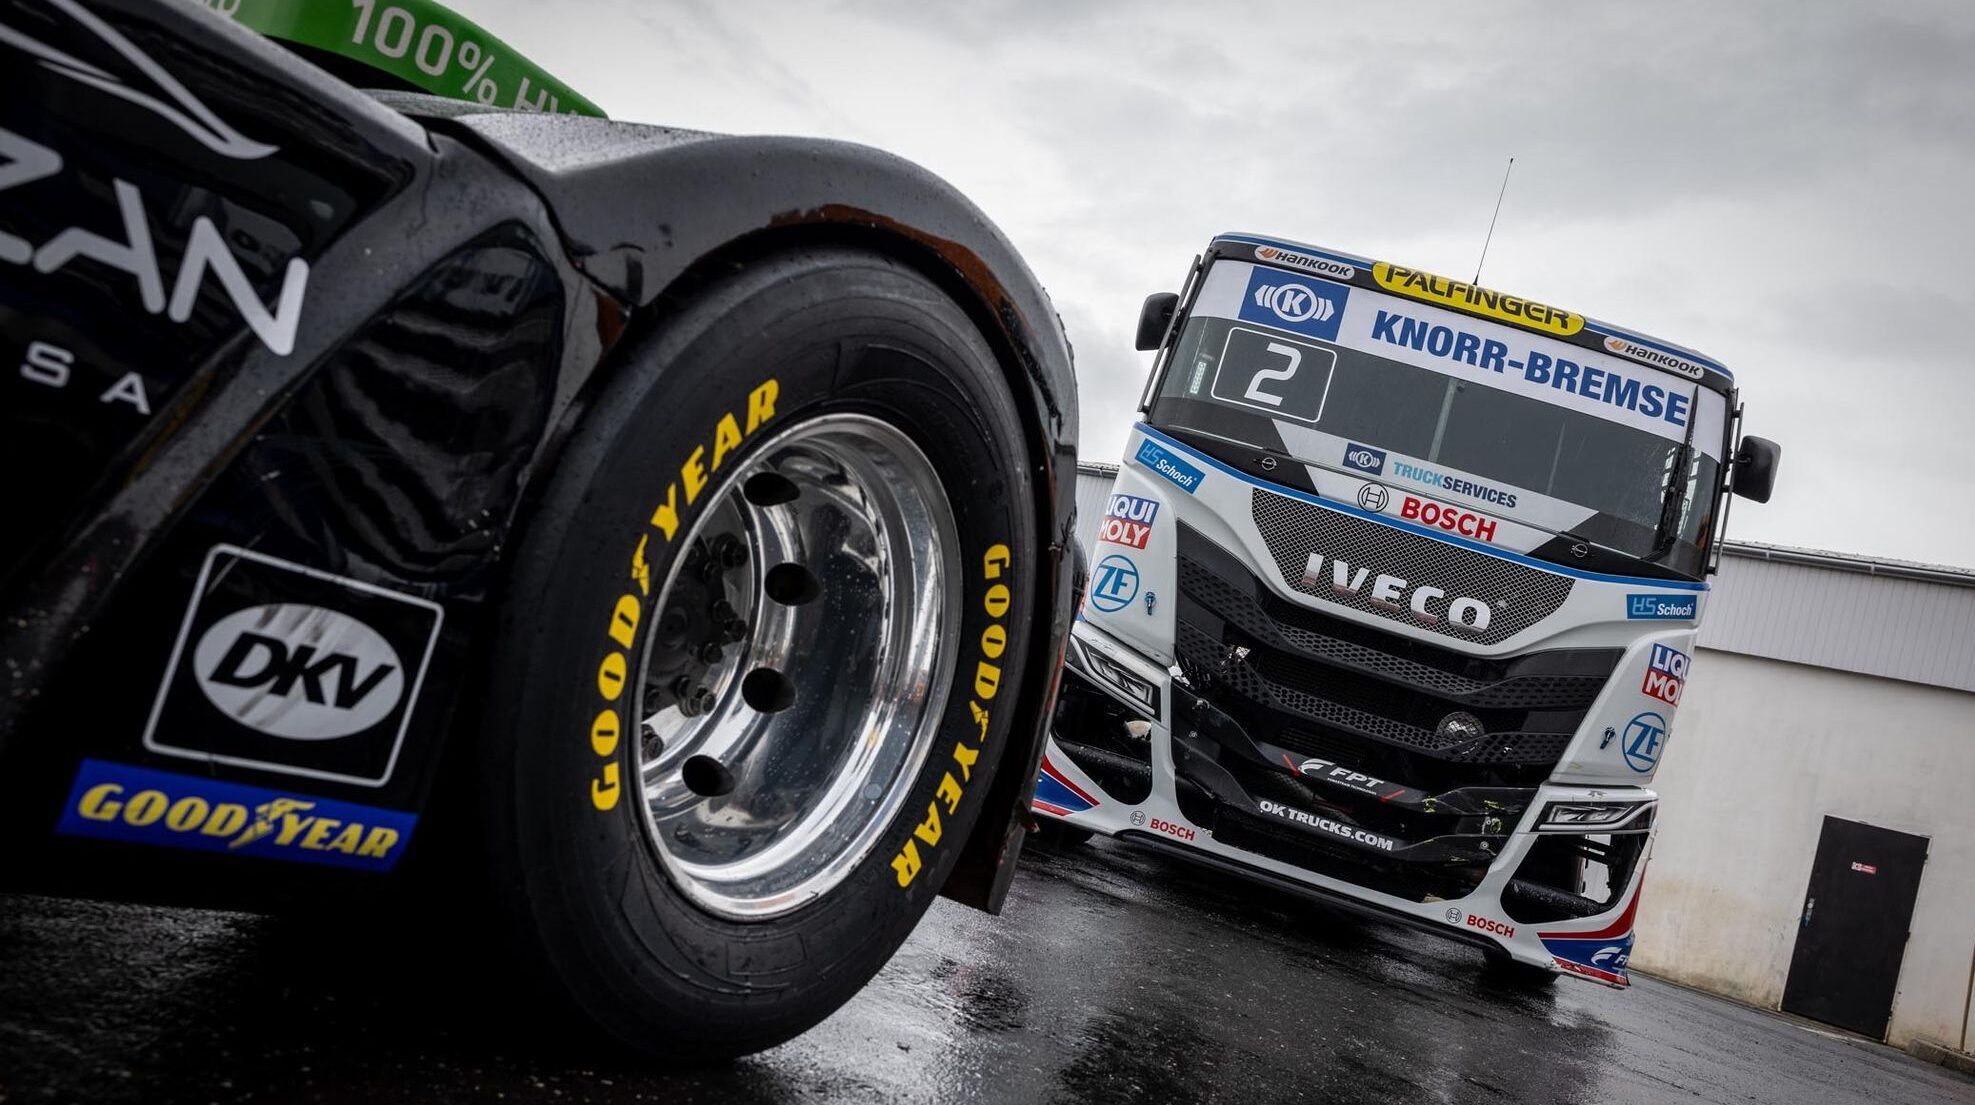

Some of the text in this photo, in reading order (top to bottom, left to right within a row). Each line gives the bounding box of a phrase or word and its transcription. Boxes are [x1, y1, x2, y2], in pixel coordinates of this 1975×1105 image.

[350, 0, 498, 106] 100%
[1386, 265, 1570, 330] PALFINGER
[1244, 342, 1301, 406] 2
[1371, 310, 1689, 427] KNORR-BREMSE
[1156, 458, 1194, 487] Schoch
[1400, 496, 1497, 542] BOSCH
[591, 378, 780, 811] GOODYEAR
[1094, 563, 1137, 605] ZF
[1301, 552, 1491, 634] IVECO
[1657, 603, 1693, 616] Schoch
[208, 631, 396, 710] DKV
[890, 543, 1010, 888] GOODYEAR
[1626, 720, 1665, 763] ZF
[1329, 767, 1385, 788] FPT
[78, 784, 399, 859] GOODYEAR
[1150, 818, 1195, 841] BOSCH
[1288, 808, 1393, 851] TRUCKS.COM
[1466, 914, 1515, 938] BOSCH
